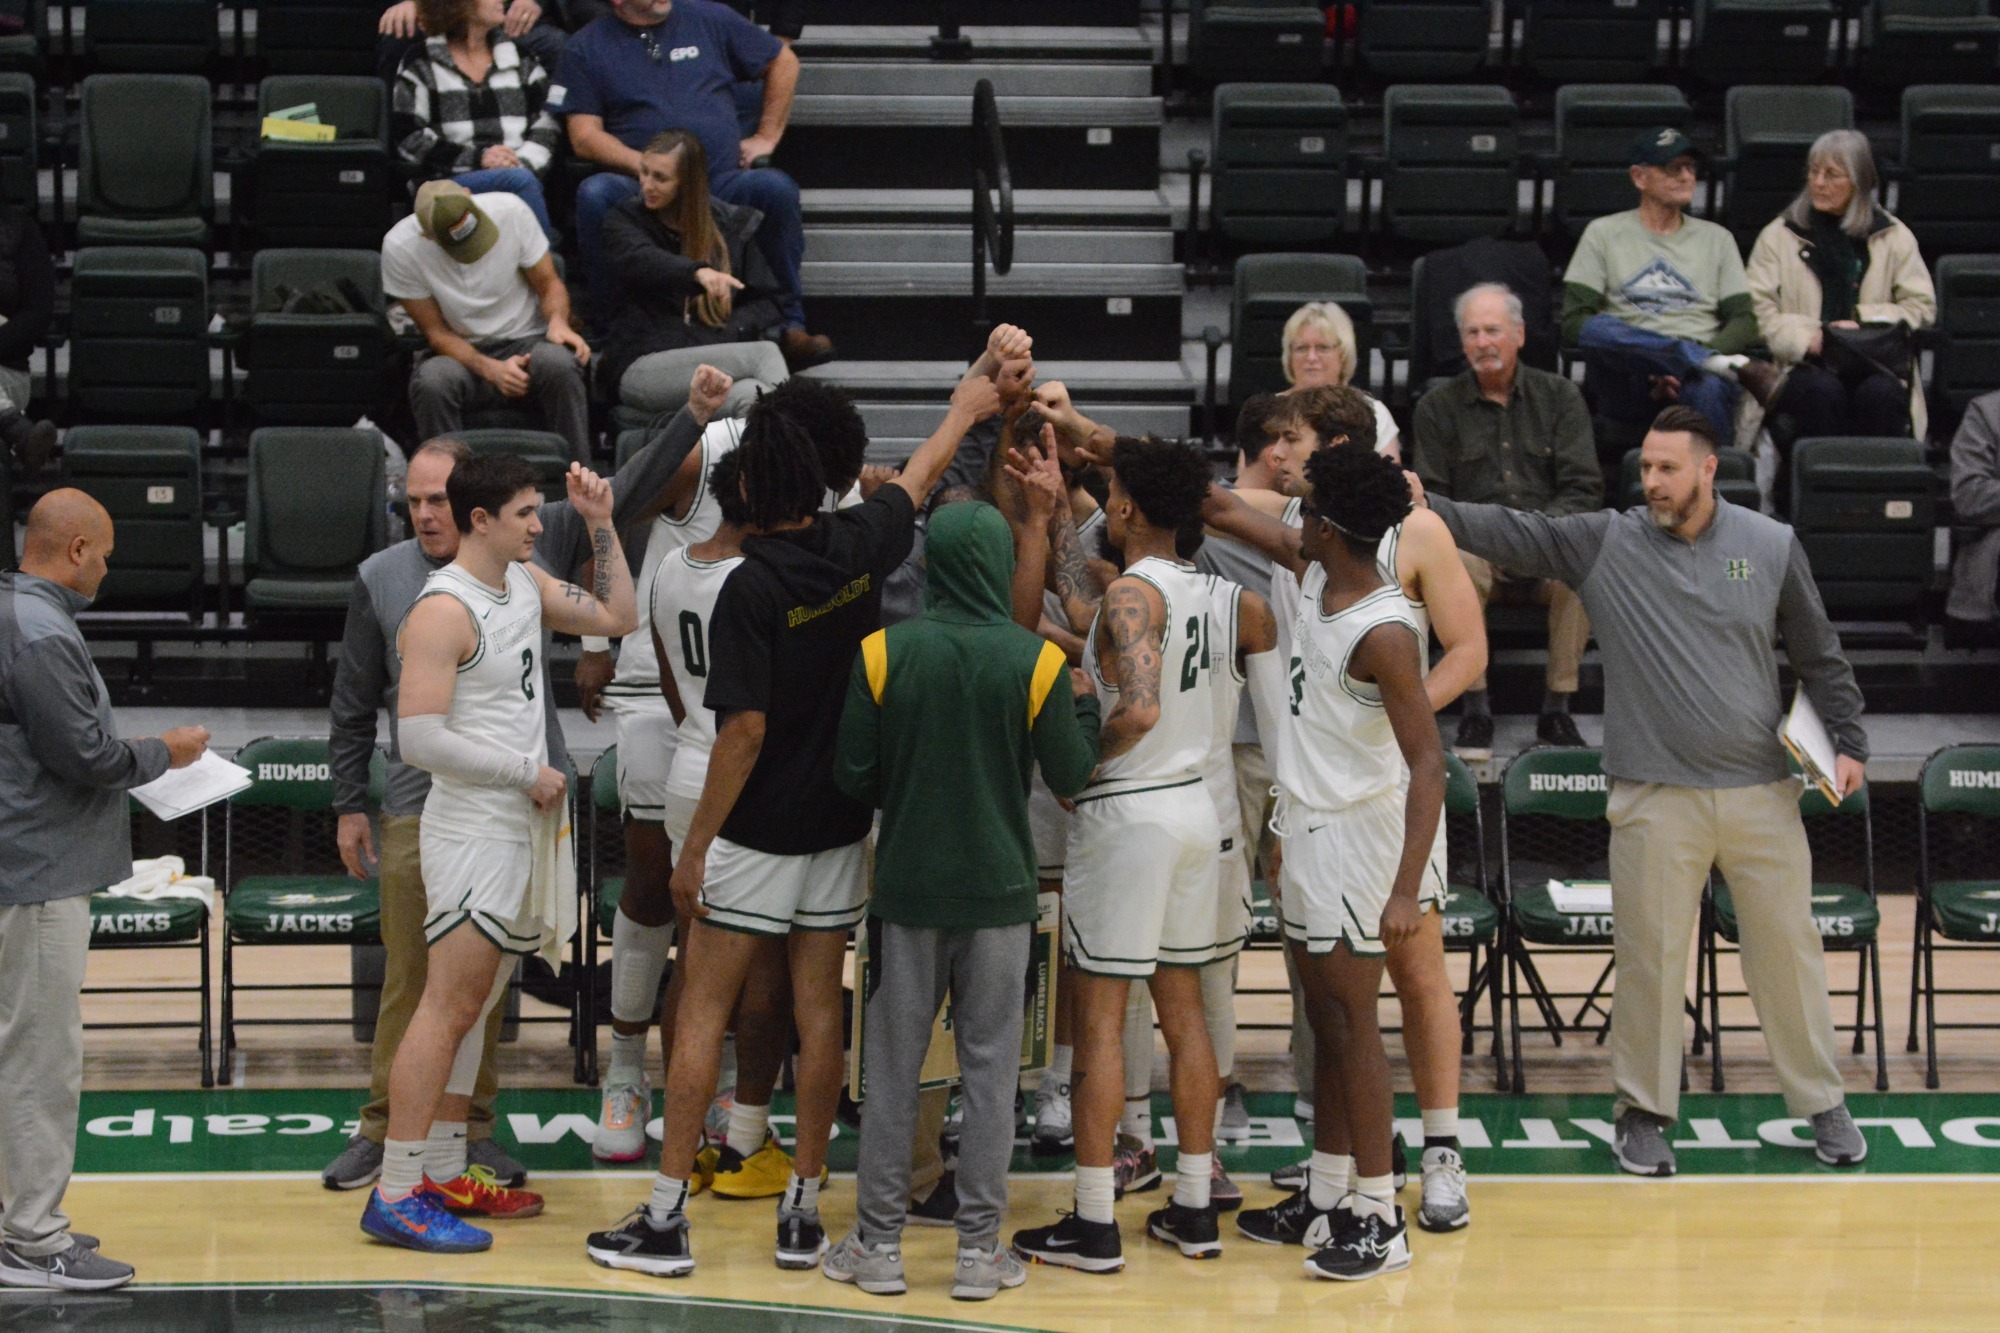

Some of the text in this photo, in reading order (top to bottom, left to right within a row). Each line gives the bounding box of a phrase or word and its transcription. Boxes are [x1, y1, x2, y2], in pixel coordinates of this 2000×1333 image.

[521, 647, 536, 702] 2
[257, 762, 333, 782] HUMBO
[263, 913, 355, 933] JACKS
[1035, 961, 1047, 1042] LUMBERJACKS
